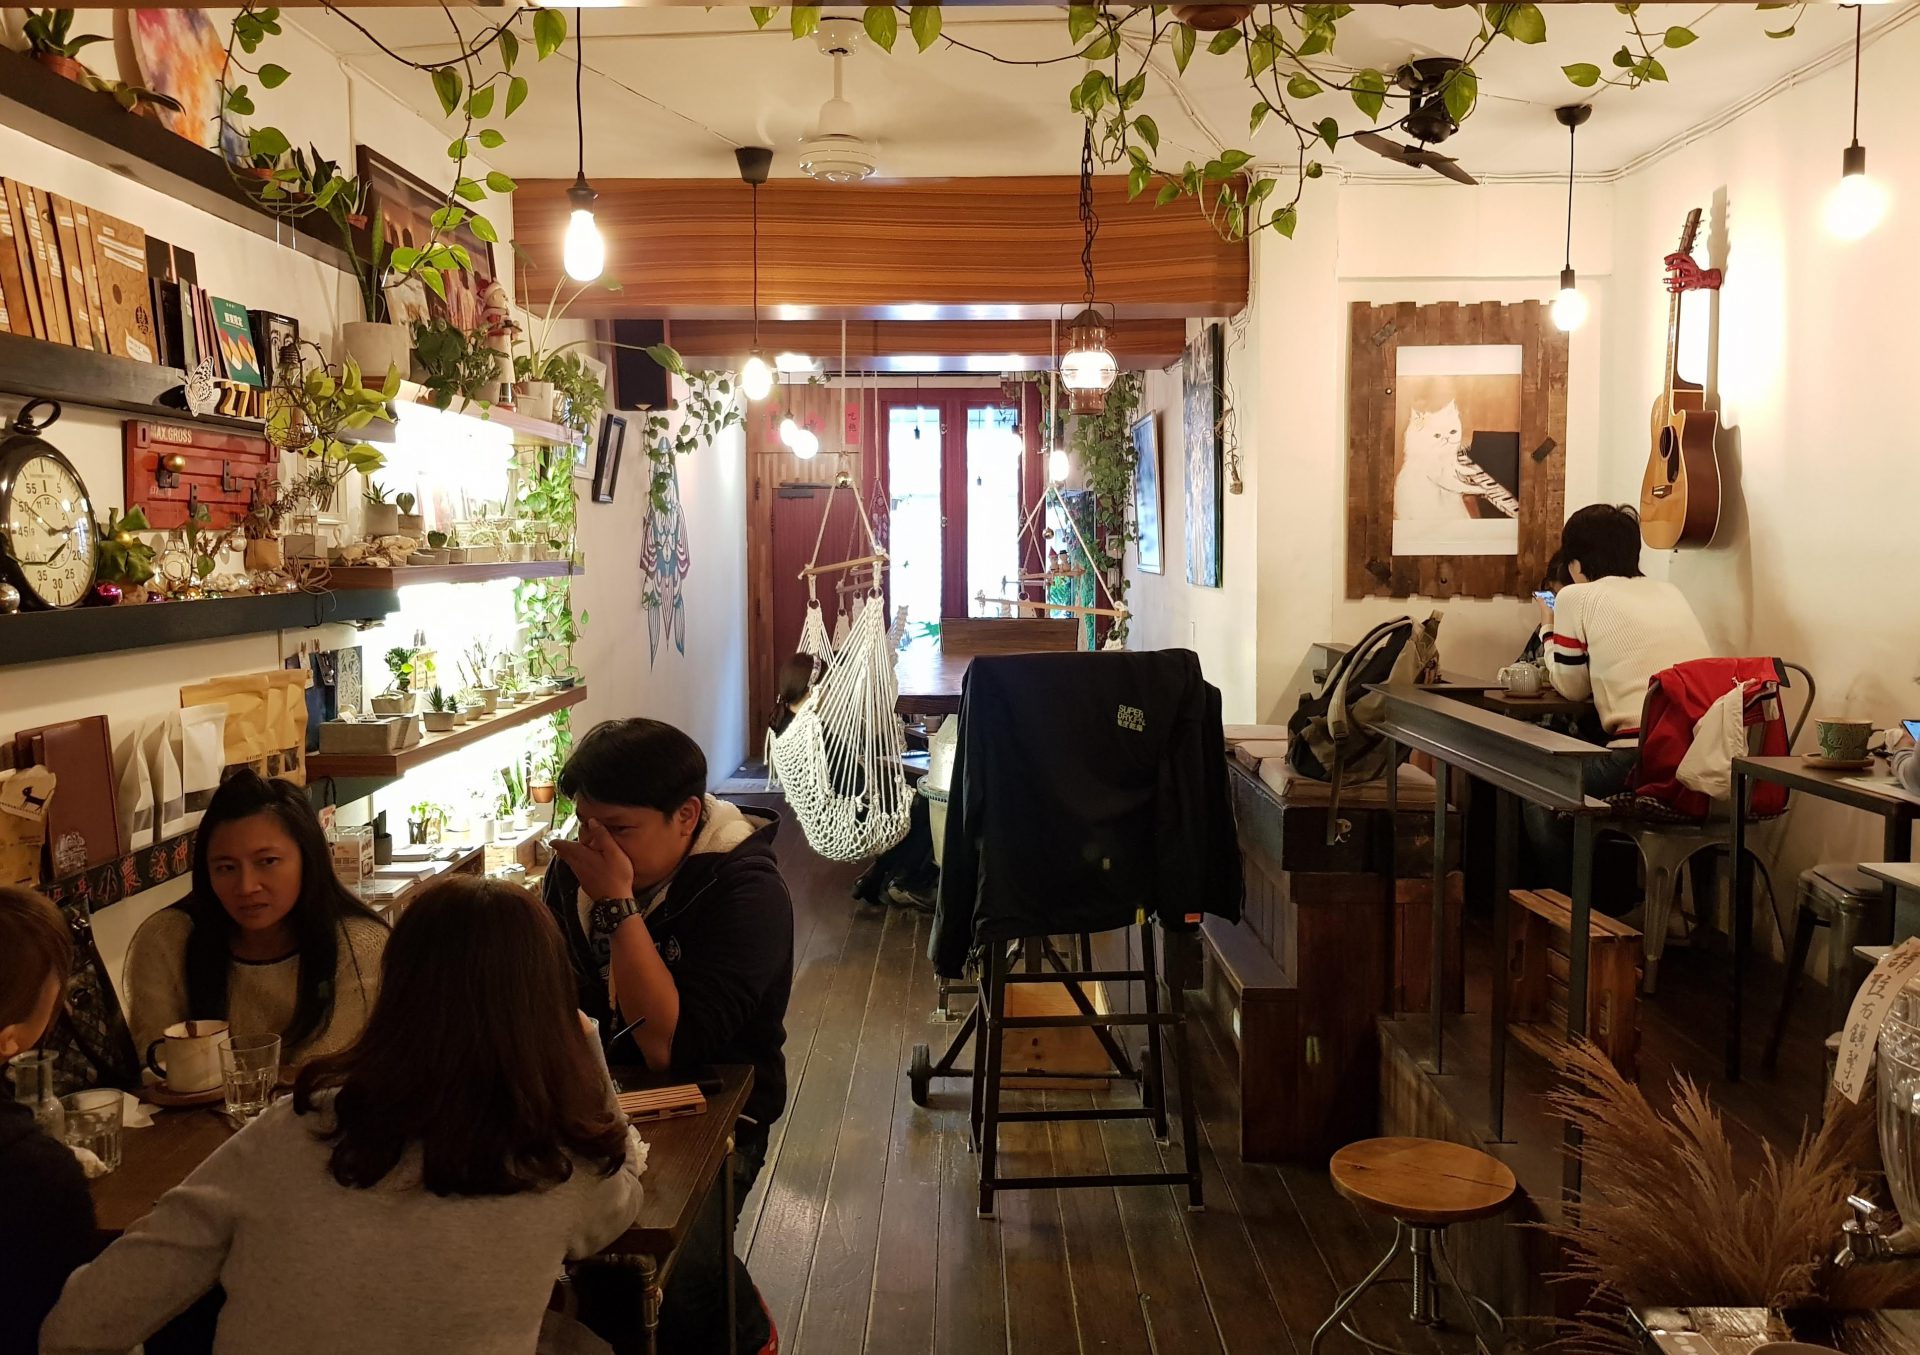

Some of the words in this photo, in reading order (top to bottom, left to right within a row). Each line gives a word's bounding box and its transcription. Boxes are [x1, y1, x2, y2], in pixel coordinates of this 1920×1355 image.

[26, 482, 37, 494] 55
[56, 482, 62, 494] 5
[18, 526, 29, 537] 45
[72, 550, 82, 561] 20
[37, 570, 48, 581] 35
[64, 568, 75, 580] 25
[52, 578, 63, 590] 30
[1119, 704, 1144, 719] SUPER
